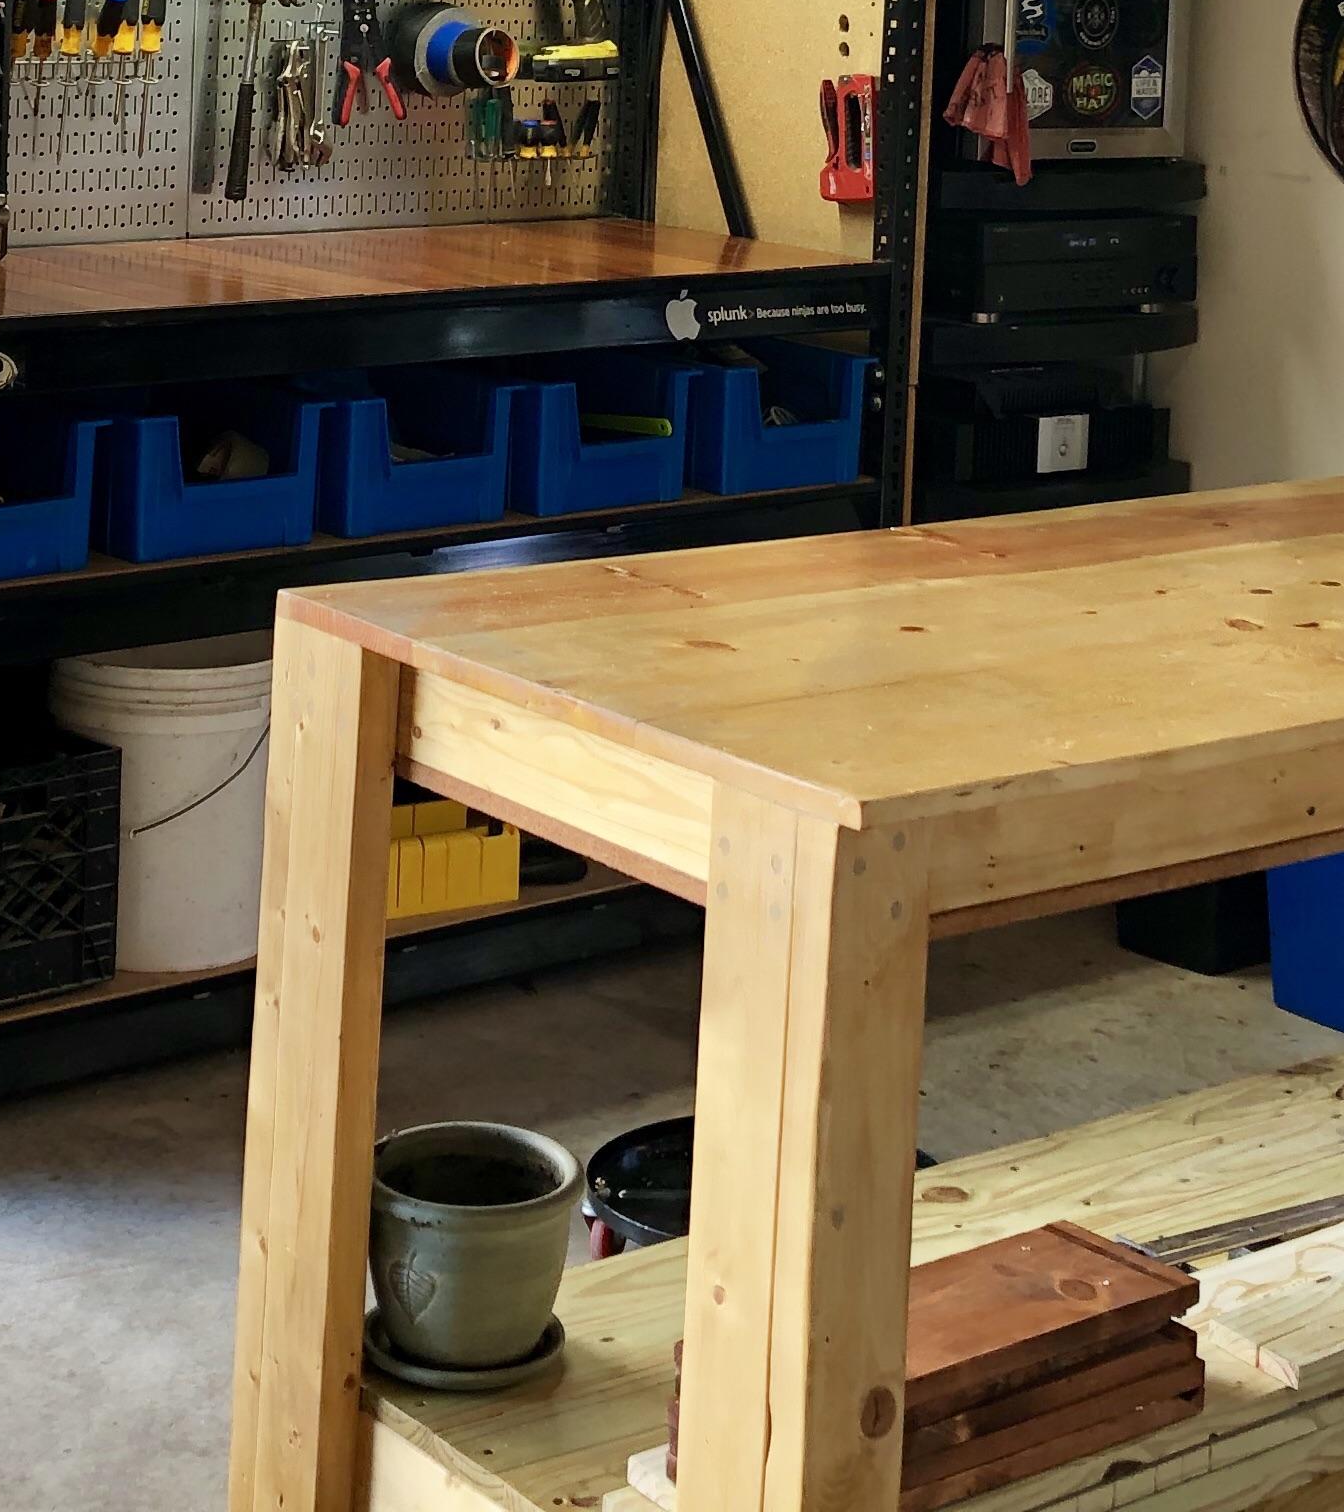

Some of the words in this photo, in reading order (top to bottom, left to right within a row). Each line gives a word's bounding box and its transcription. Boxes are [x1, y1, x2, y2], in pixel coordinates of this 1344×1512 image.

[1072, 73, 1114, 93] MAGIC
[1076, 95, 1109, 110] HAT
[756, 307, 791, 320] Because
[792, 305, 815, 318] ninjas
[816, 306, 829, 316] are
[830, 304, 845, 314] too
